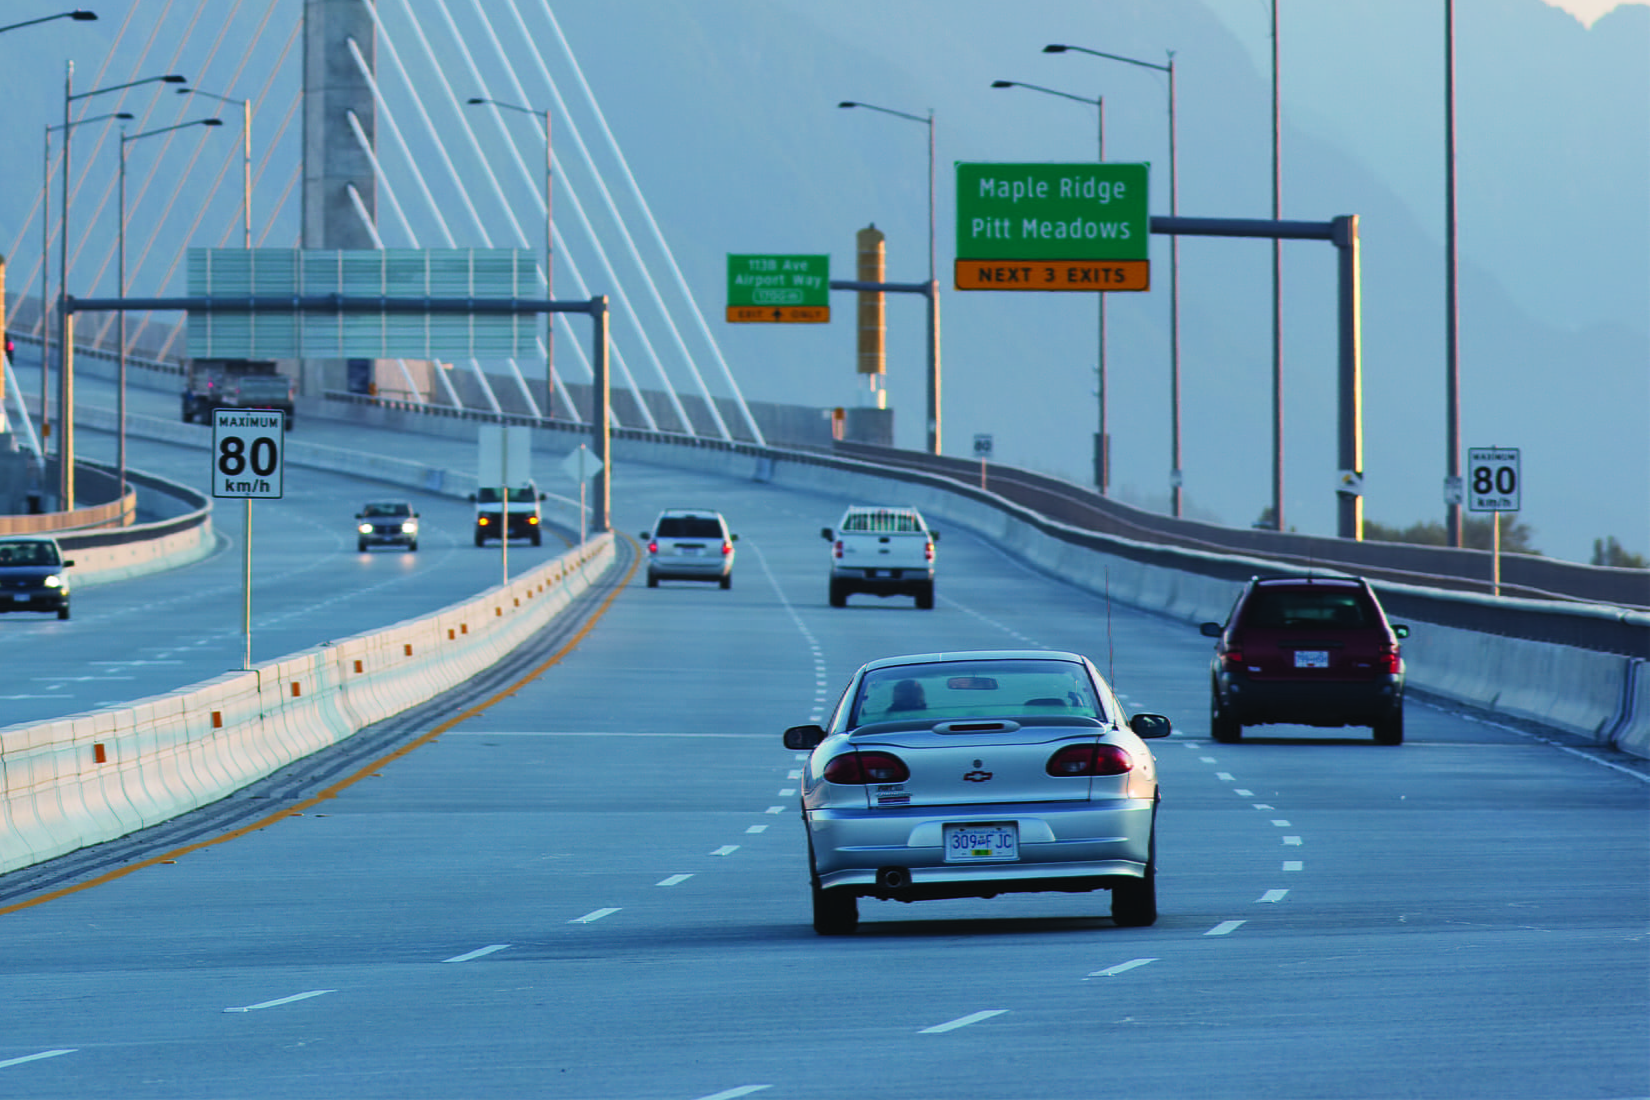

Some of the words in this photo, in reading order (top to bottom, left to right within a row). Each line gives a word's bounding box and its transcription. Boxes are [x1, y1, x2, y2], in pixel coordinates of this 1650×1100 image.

[979, 176, 1049, 204] Maple
[1060, 176, 1126, 204] Ridge
[972, 217, 1011, 239] Pitt
[1022, 217, 1131, 239] Meadows
[782, 259, 809, 271] Ave
[735, 274, 785, 288] Airport
[792, 274, 823, 289] Way
[978, 267, 1032, 283] NEXT
[1044, 267, 1055, 283] 3
[1067, 267, 1126, 284] EXITS
[738, 310, 763, 319] EXIT
[790, 310, 822, 319] ONLY
[219, 416, 278, 428] MAXIMUM
[218, 436, 278, 477] 80
[1473, 453, 1516, 461] MAXIMUM
[225, 479, 271, 493] km/h
[1473, 466, 1516, 495] 80
[1477, 497, 1511, 507] km/h
